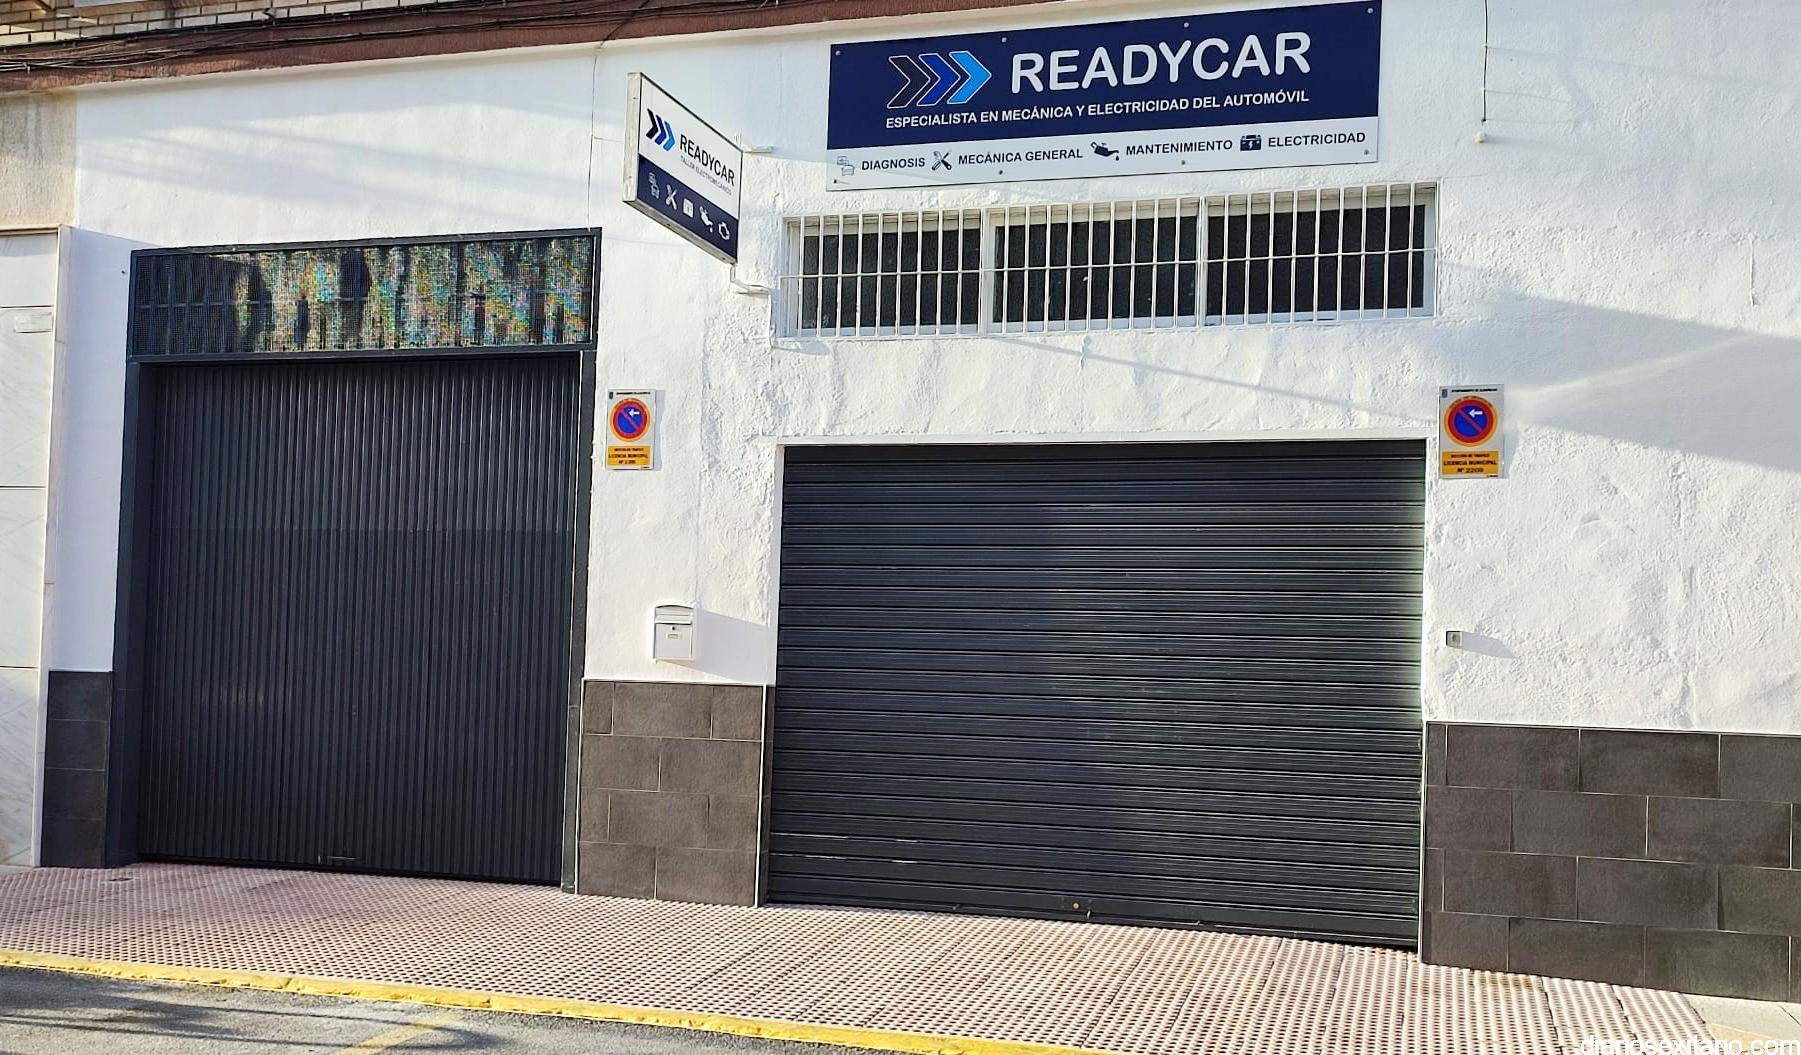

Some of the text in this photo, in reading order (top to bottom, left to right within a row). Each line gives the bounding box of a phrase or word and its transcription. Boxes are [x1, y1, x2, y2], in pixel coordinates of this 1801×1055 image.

[1011, 31, 1311, 94] READYCAR
[885, 88, 1310, 128] ESPECIALISTA EN MECÁNICA Y ELECTRICIDAD DEL AUTOMÓVIL
[1125, 139, 1233, 156] MANTENIMIENTO
[1268, 132, 1366, 147] ELECTRICIDAD
[680, 133, 735, 187] READYCAR
[861, 156, 926, 171] DIAGNOSIS
[958, 148, 1084, 165] MECÁNICA GENERAL
